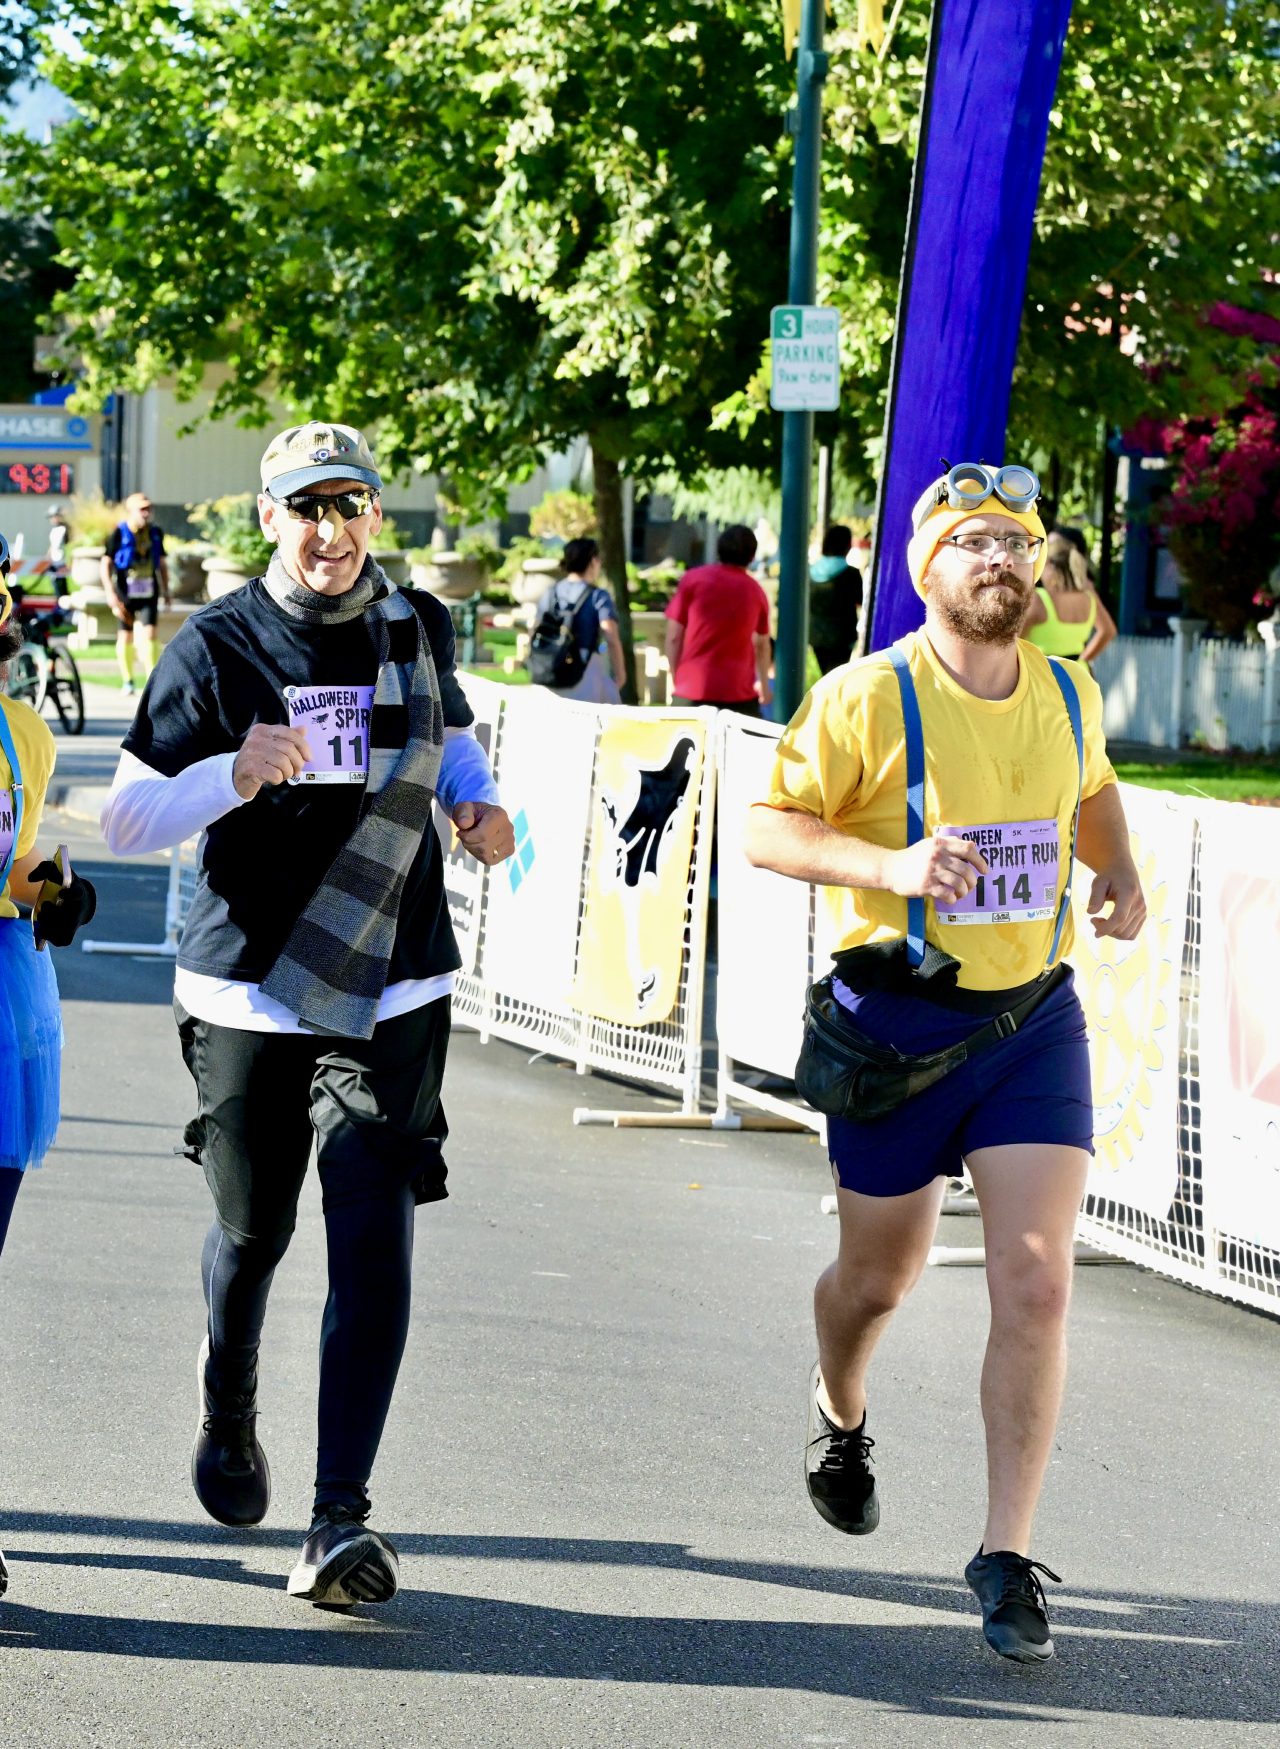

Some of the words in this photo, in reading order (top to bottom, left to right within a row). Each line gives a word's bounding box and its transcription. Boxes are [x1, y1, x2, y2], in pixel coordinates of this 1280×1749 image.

[781, 314, 797, 337] 3
[776, 344, 834, 362] PARKING
[334, 707, 371, 732] SPIR
[327, 735, 363, 766] 11
[961, 829, 1002, 847] OWEEN
[979, 845, 1027, 870] SPIRIT
[1031, 842, 1058, 867] RUN
[975, 873, 1032, 907] 114
